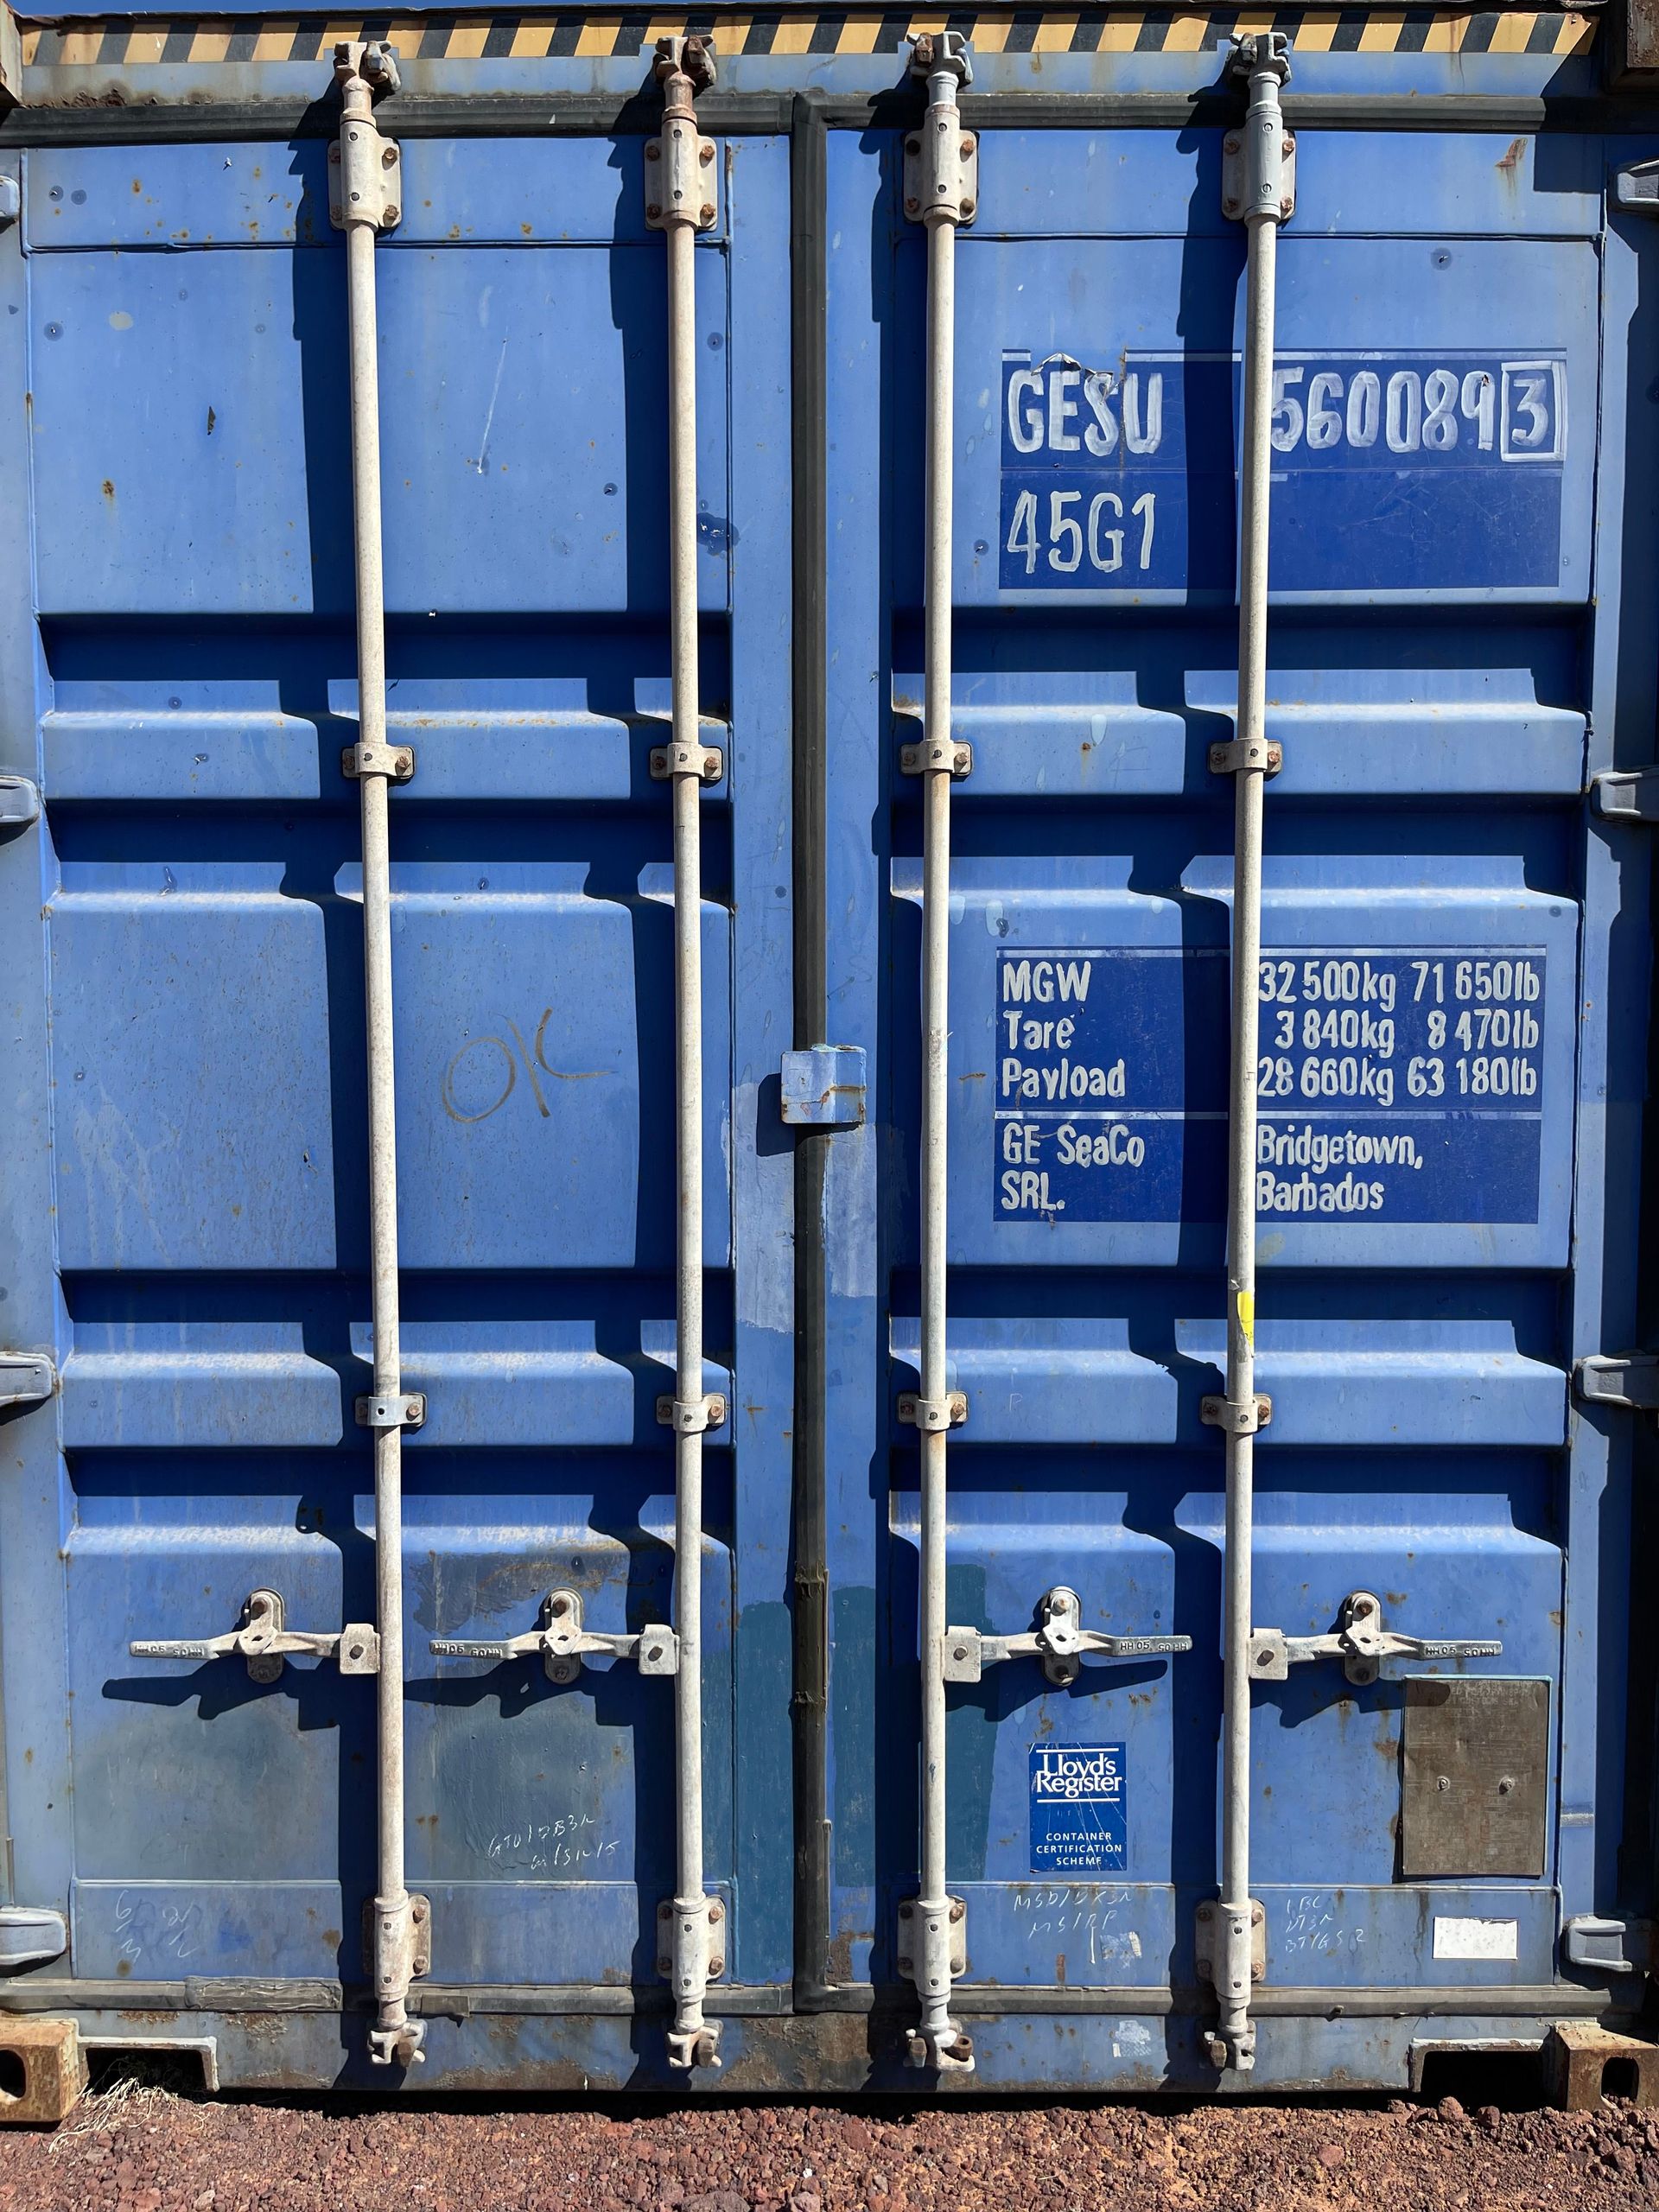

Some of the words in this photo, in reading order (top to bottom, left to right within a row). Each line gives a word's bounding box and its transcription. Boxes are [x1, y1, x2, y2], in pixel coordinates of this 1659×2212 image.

[1008, 369, 1163, 456] GESU
[1007, 489, 1156, 574] 45G1
[1003, 959, 1091, 1003] MGW
[1002, 1009, 1076, 1051] Tare
[1302, 1008, 1395, 1058] 840kg
[1002, 1057, 1126, 1101] Payload
[1002, 1122, 1041, 1165] GE
[1057, 1123, 1146, 1168] SeaCo
[1257, 1124, 1423, 1174] Bridgetown,
[1001, 1169, 1066, 1211] SRL.
[1256, 1170, 1385, 1212] Barbados
[1036, 1770, 1122, 1798] Register
[1043, 1752, 1116, 1780] Lloyd's
[1036, 1844, 1122, 1853] CERTIFICATION
[1046, 1832, 1112, 1841] CONTAINER
